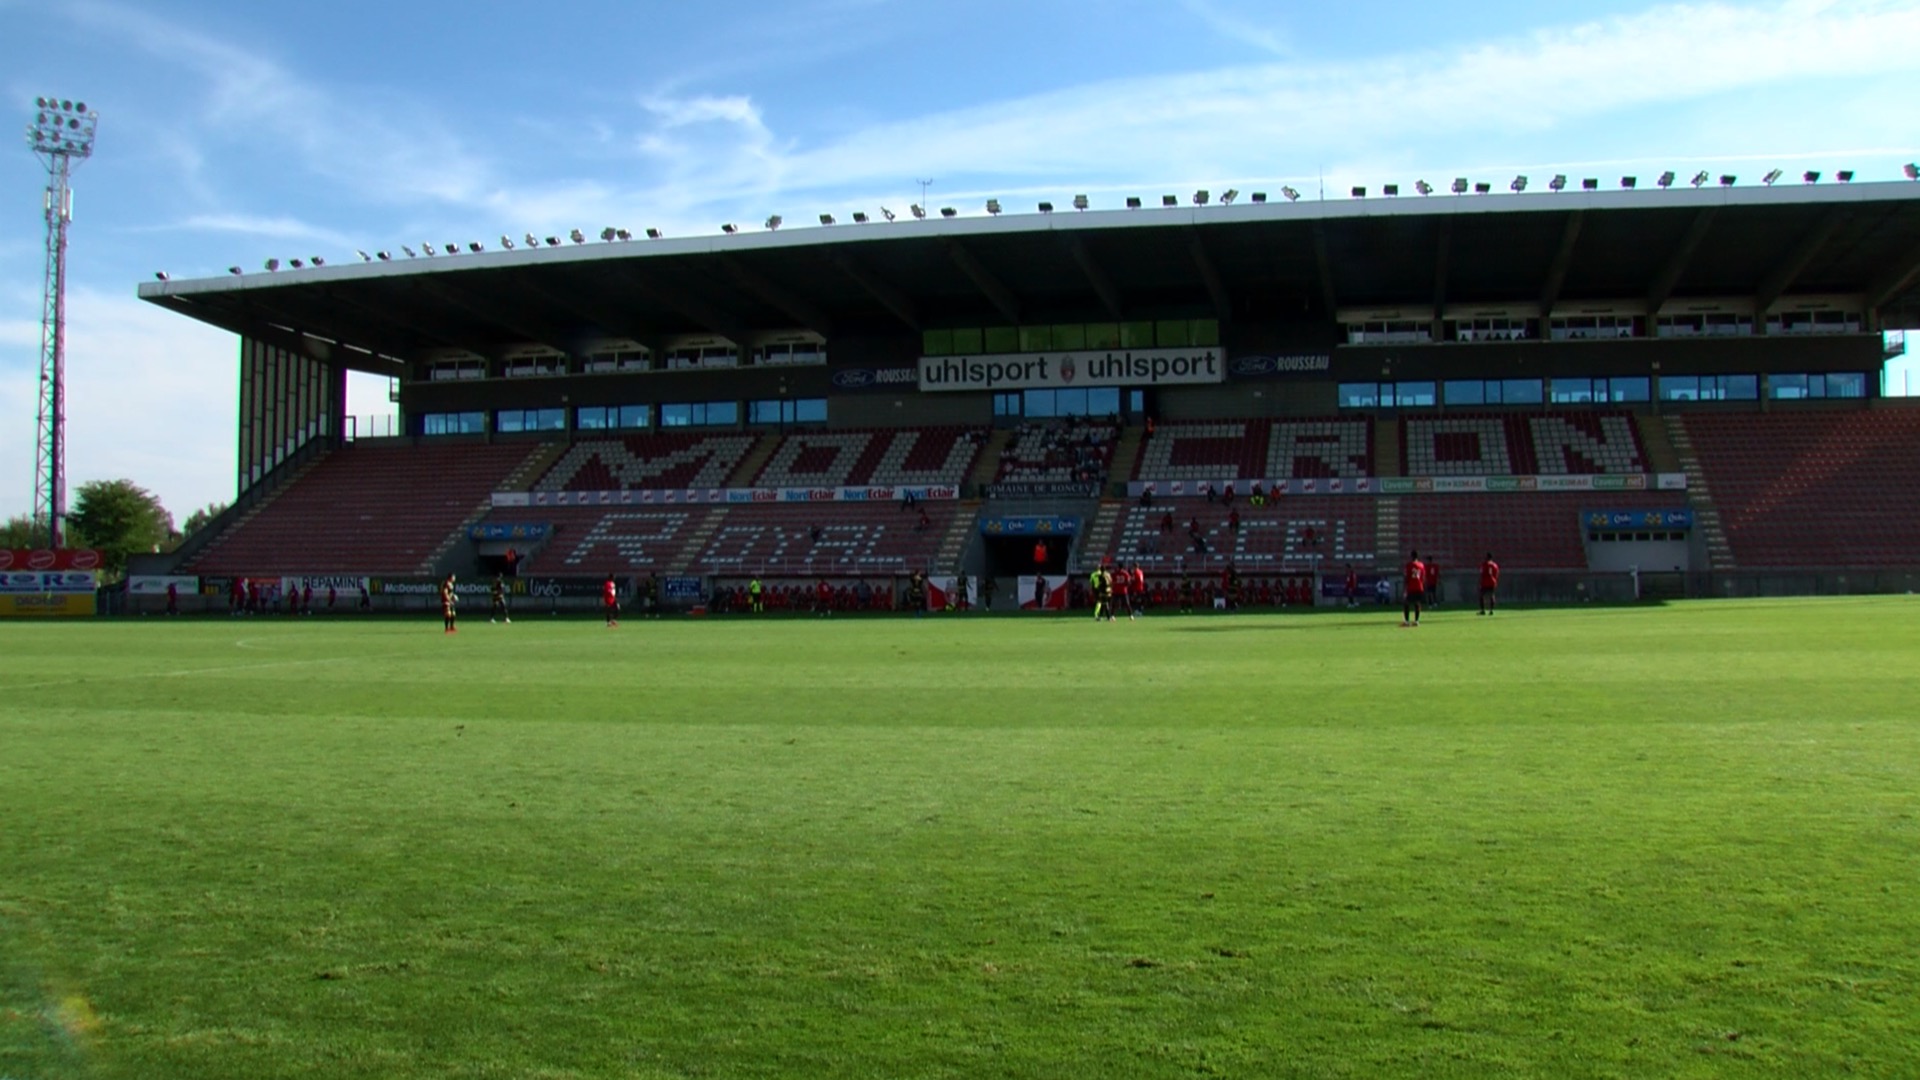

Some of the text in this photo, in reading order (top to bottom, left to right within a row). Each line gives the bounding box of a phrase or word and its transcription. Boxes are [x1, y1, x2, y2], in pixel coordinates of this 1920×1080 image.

[1088, 352, 1215, 382] uhlsport
[1276, 355, 1329, 371] ROUSSEAU
[875, 368, 917, 384] ROUSSEA
[926, 357, 1047, 387] uhlsport
[1034, 484, 1045, 493] DE
[1050, 483, 1091, 493] RONCEV
[384, 582, 438, 593] McDonald's
[455, 582, 511, 593] McDons
